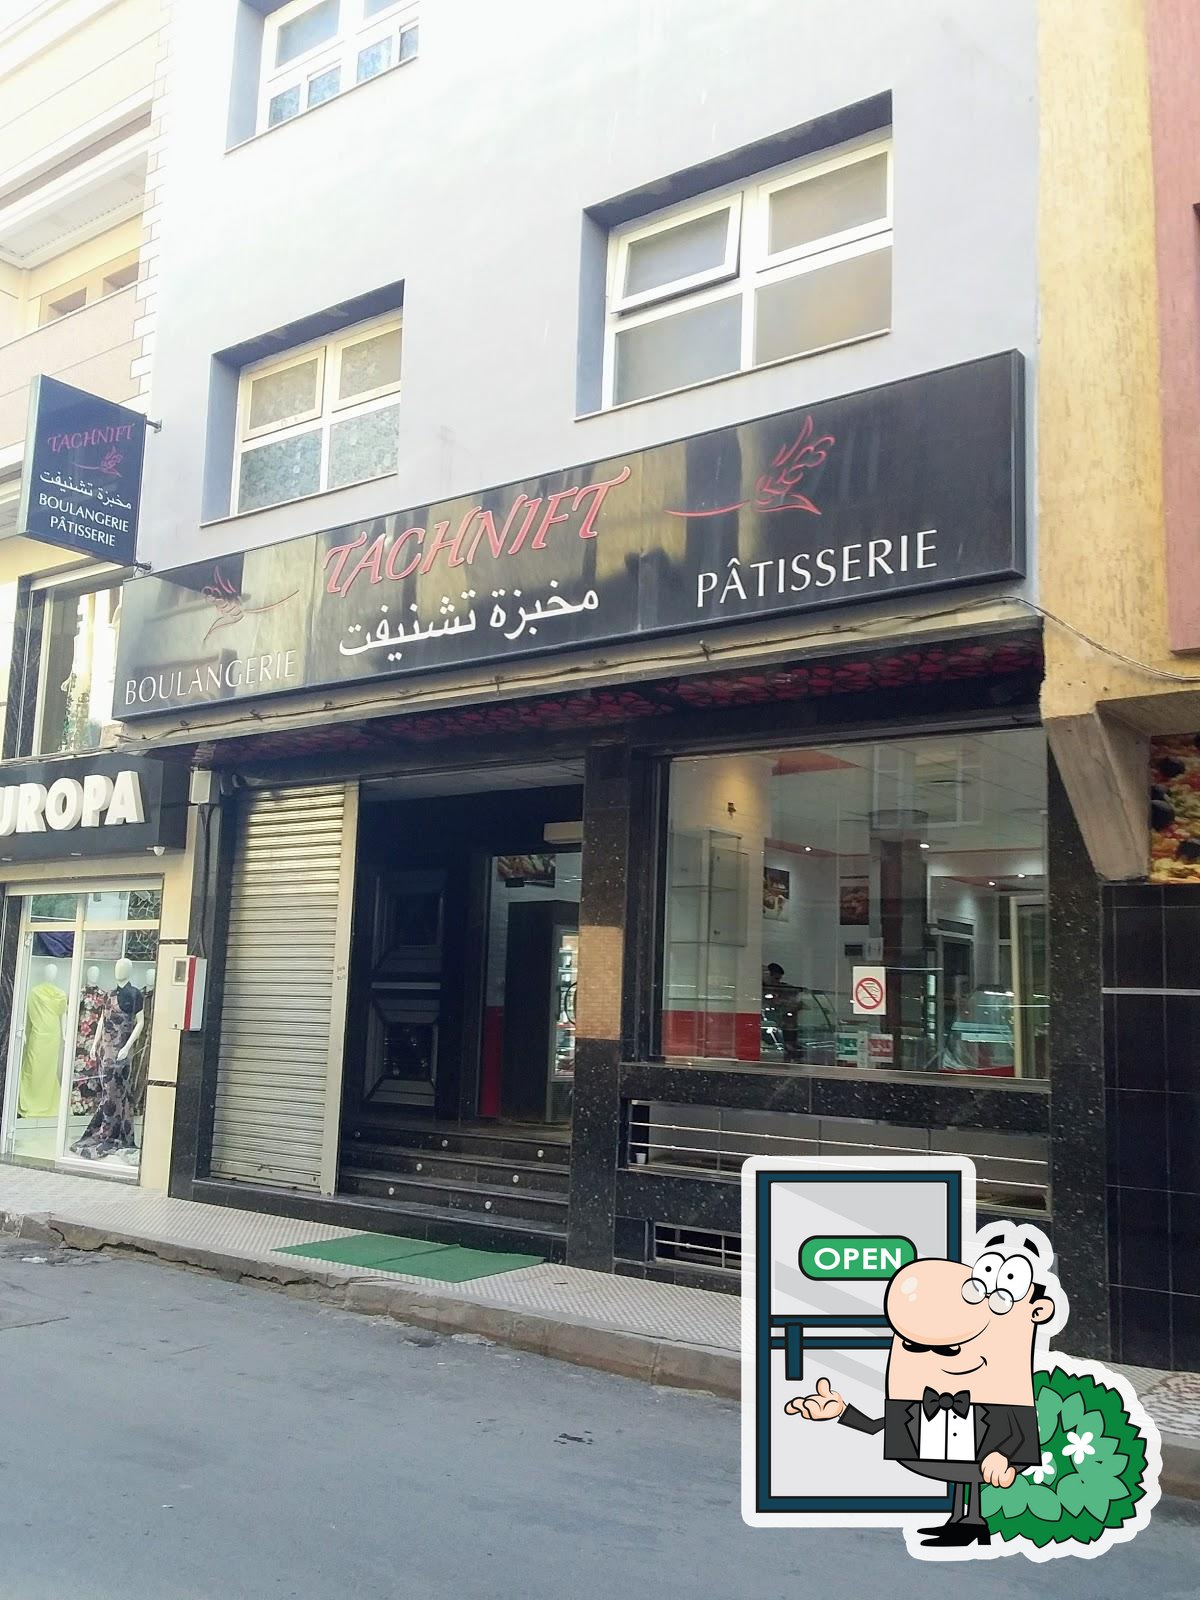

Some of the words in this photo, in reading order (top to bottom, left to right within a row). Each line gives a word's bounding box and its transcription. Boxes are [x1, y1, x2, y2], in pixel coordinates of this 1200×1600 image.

[48, 423, 135, 453] TACHNIFT
[40, 471, 93, 497] تشنيفت
[97, 487, 132, 509] مخبزة
[39, 492, 129, 533] BOULANGERIE
[50, 515, 116, 547] PÂTISSERIE
[322, 466, 631, 598] TACHNIFT
[696, 528, 938, 608] PÂTISSERIE
[338, 588, 477, 662] تشنيفت
[489, 578, 600, 640] مخبزة
[125, 648, 296, 706] BOULANGERIE
